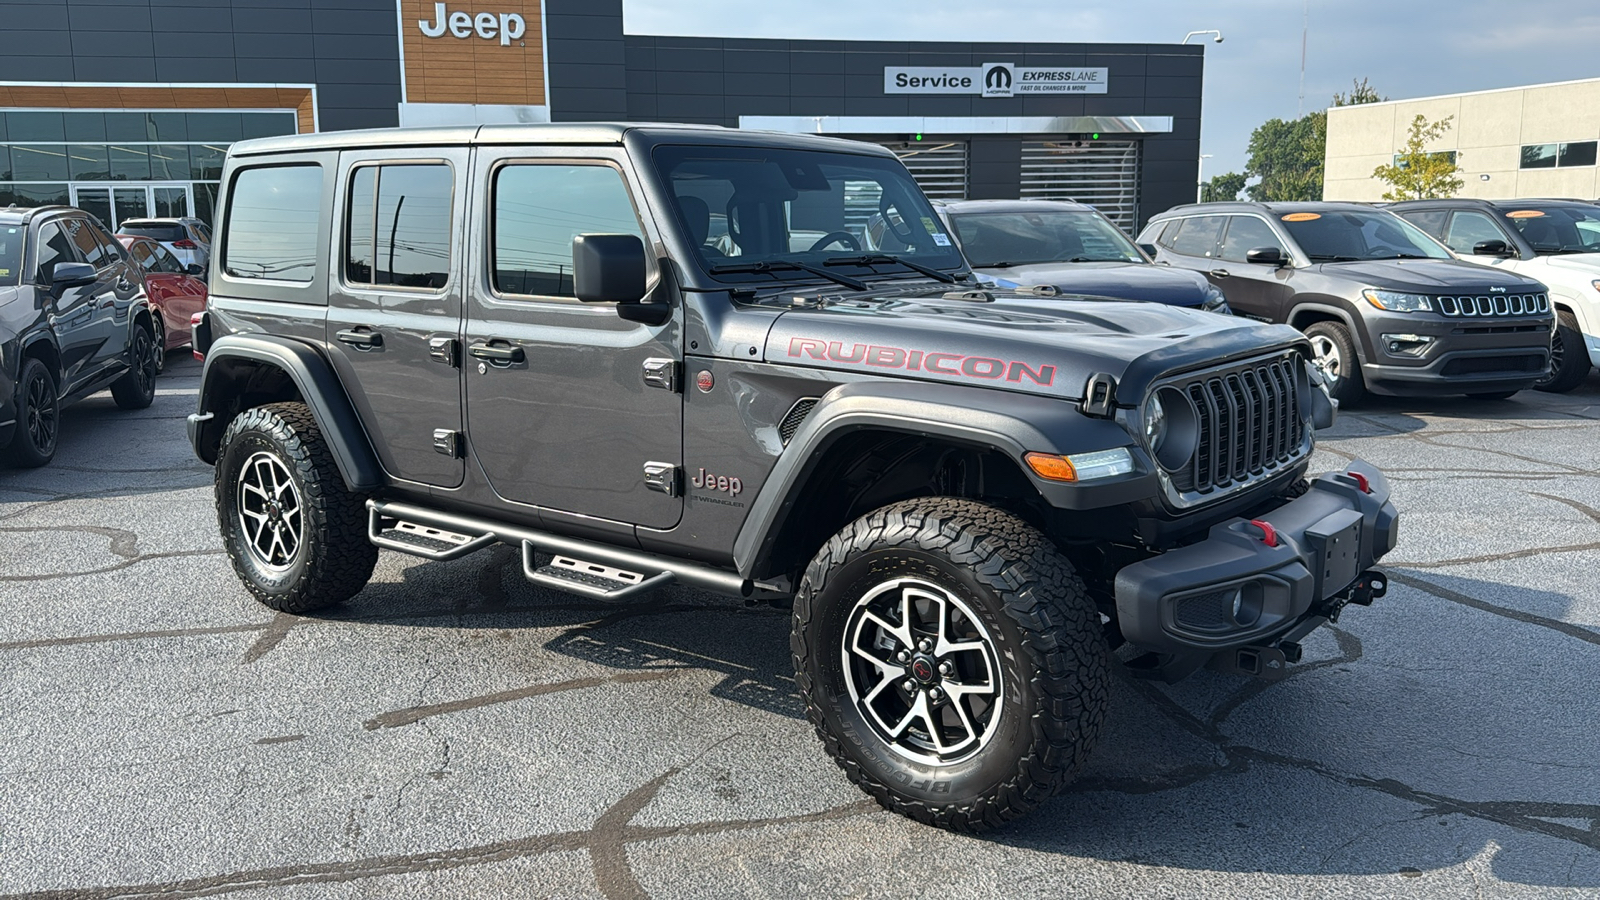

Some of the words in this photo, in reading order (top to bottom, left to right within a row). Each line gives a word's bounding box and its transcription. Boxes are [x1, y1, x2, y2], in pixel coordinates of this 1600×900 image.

[418, 2, 525, 46] Jeep
[896, 73, 972, 88] Service
[788, 337, 1057, 387] RUBICON
[692, 468, 743, 497] Jeep
[698, 496, 744, 508] WRANGLER
